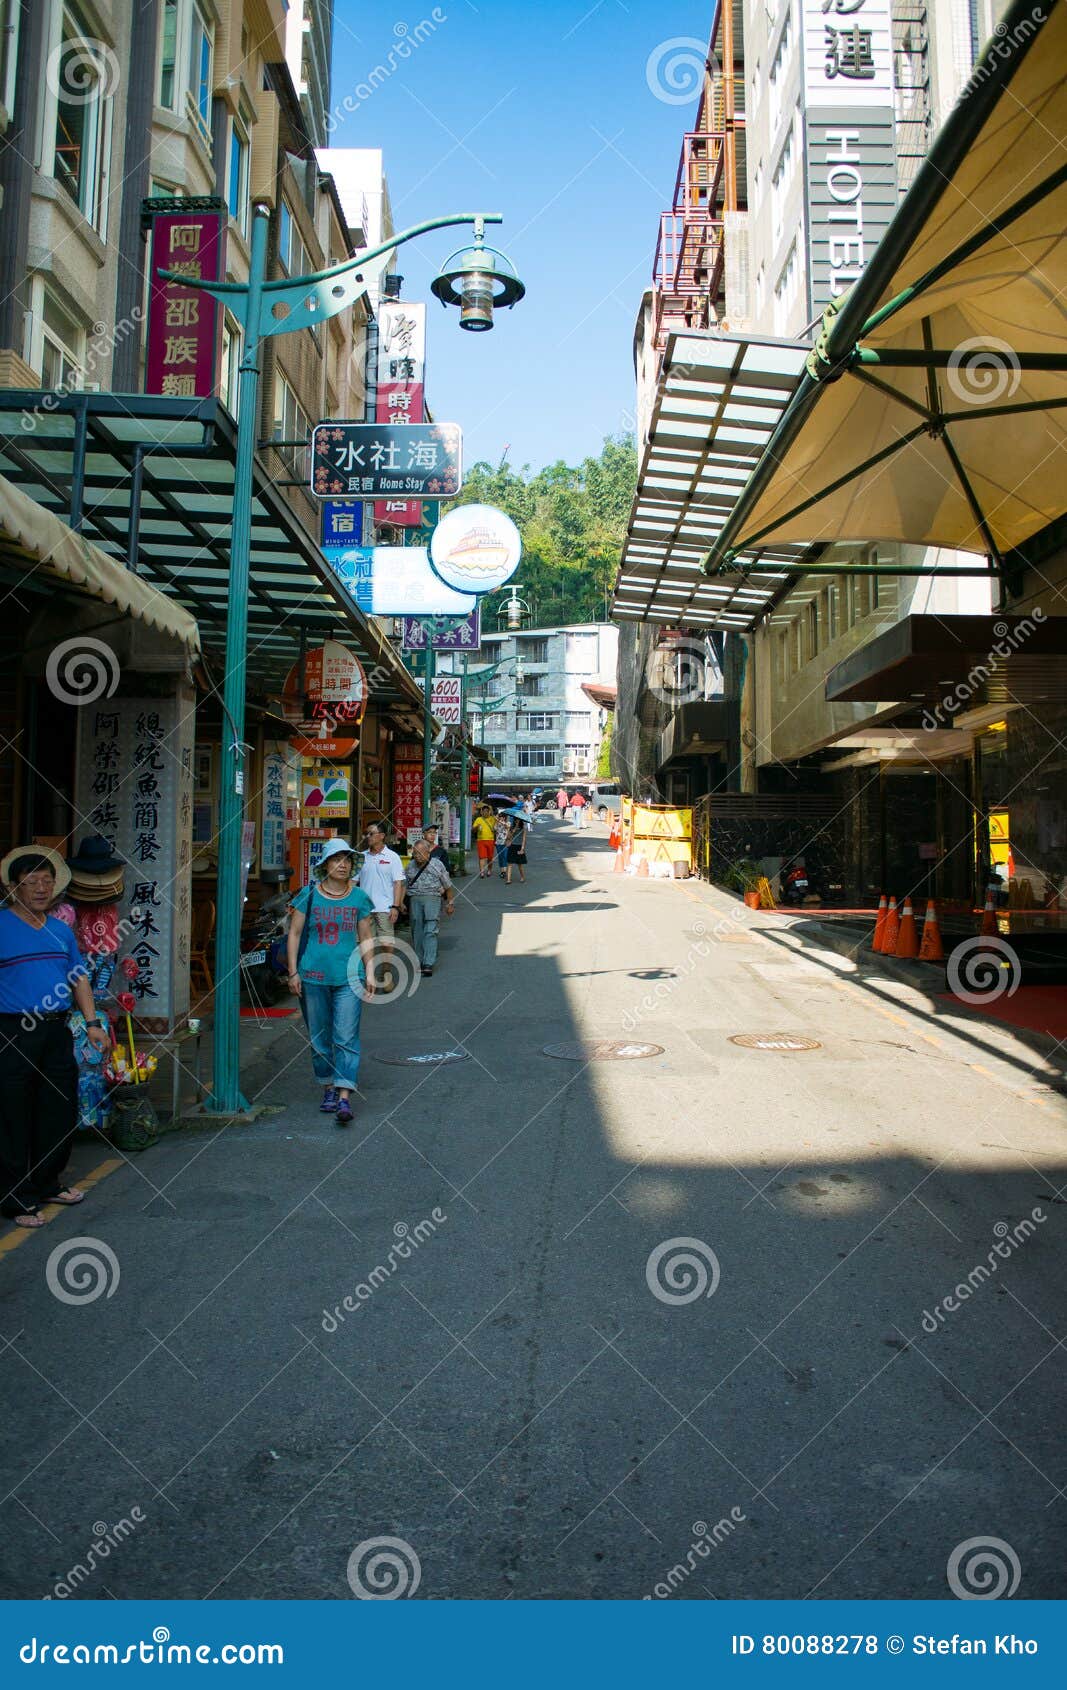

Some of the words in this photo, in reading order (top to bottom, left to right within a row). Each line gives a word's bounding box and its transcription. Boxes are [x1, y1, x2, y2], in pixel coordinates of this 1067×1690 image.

[823, 0, 875, 80] 連
[826, 129, 868, 298] HOTEL
[335, 440, 438, 471] 水社海
[347, 477, 374, 491] 民宿
[379, 478, 403, 490] Home
[404, 478, 424, 492] Stay
[408, 620, 474, 644] 創食
[436, 680, 458, 695] 600
[133, 712, 164, 862] 總統魚簡餐
[267, 765, 284, 817] 水社海
[312, 907, 358, 922] SUPER
[130, 881, 162, 1000] 風味合菜
[314, 922, 339, 945] 18
